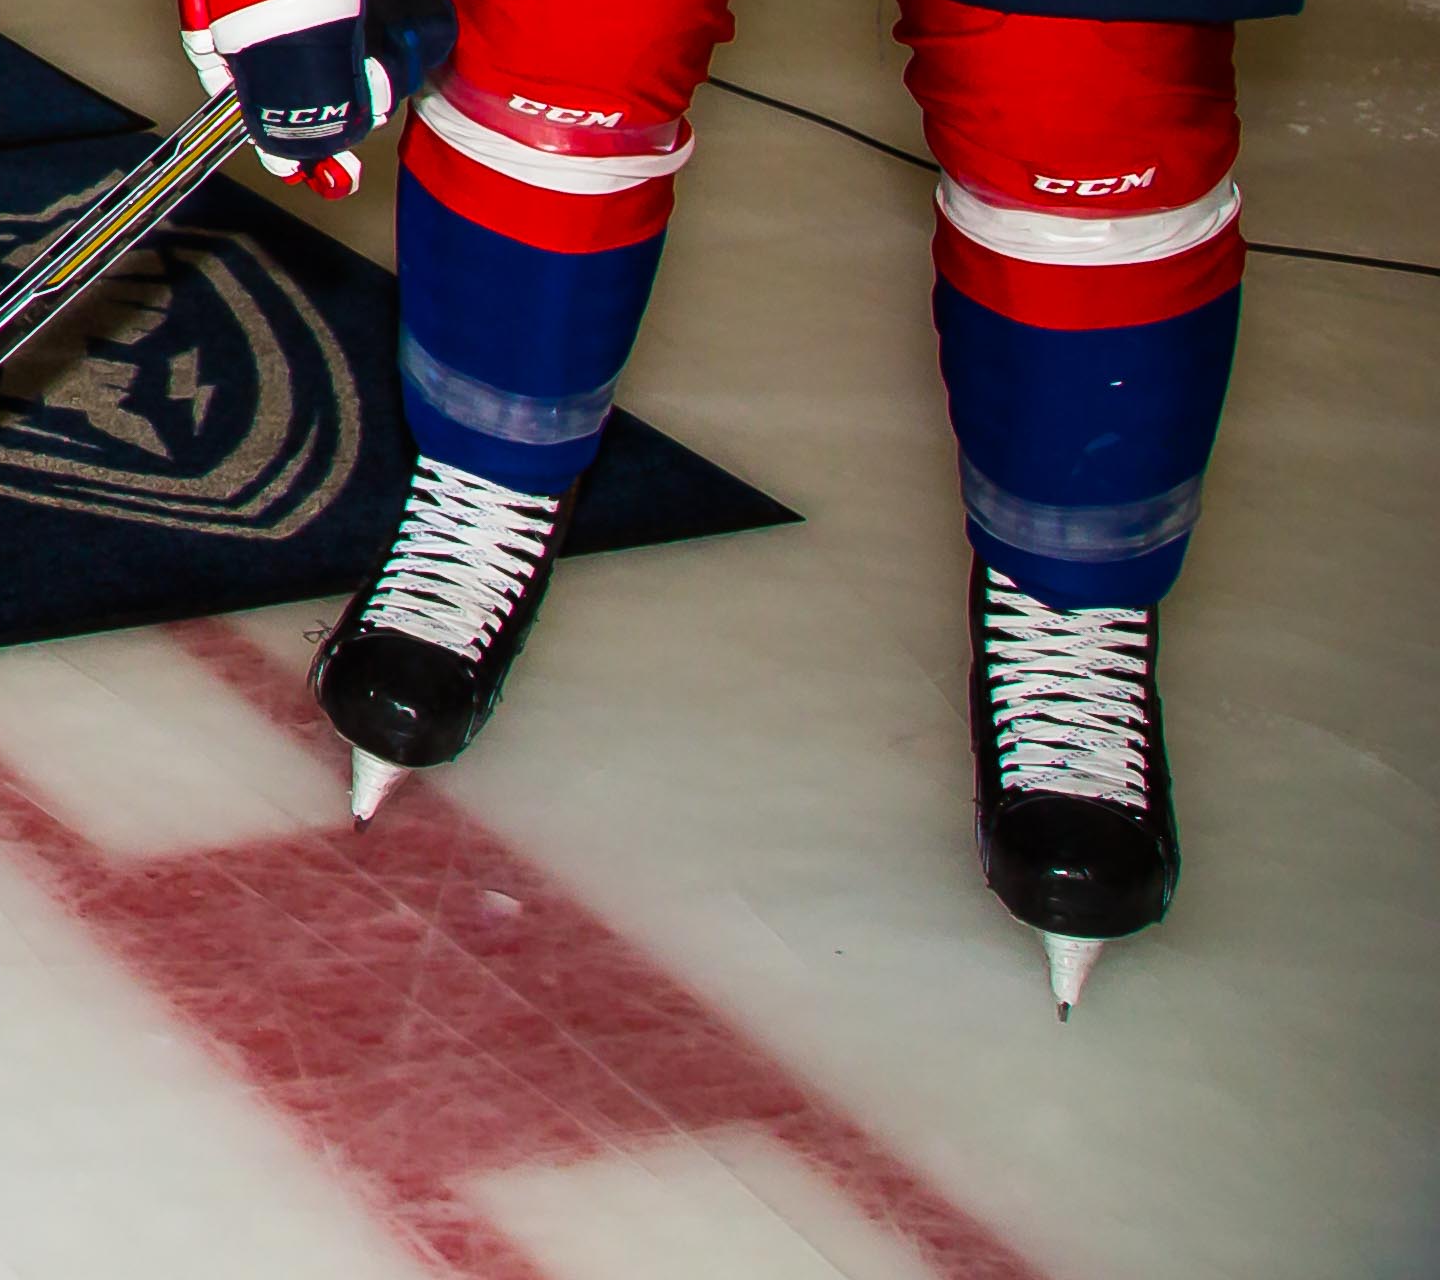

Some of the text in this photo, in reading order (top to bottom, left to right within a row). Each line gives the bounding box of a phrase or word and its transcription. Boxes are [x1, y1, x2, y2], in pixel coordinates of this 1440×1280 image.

[260, 100, 350, 128] CCM
[508, 92, 623, 130] CCM
[1033, 166, 1156, 197] CCM
